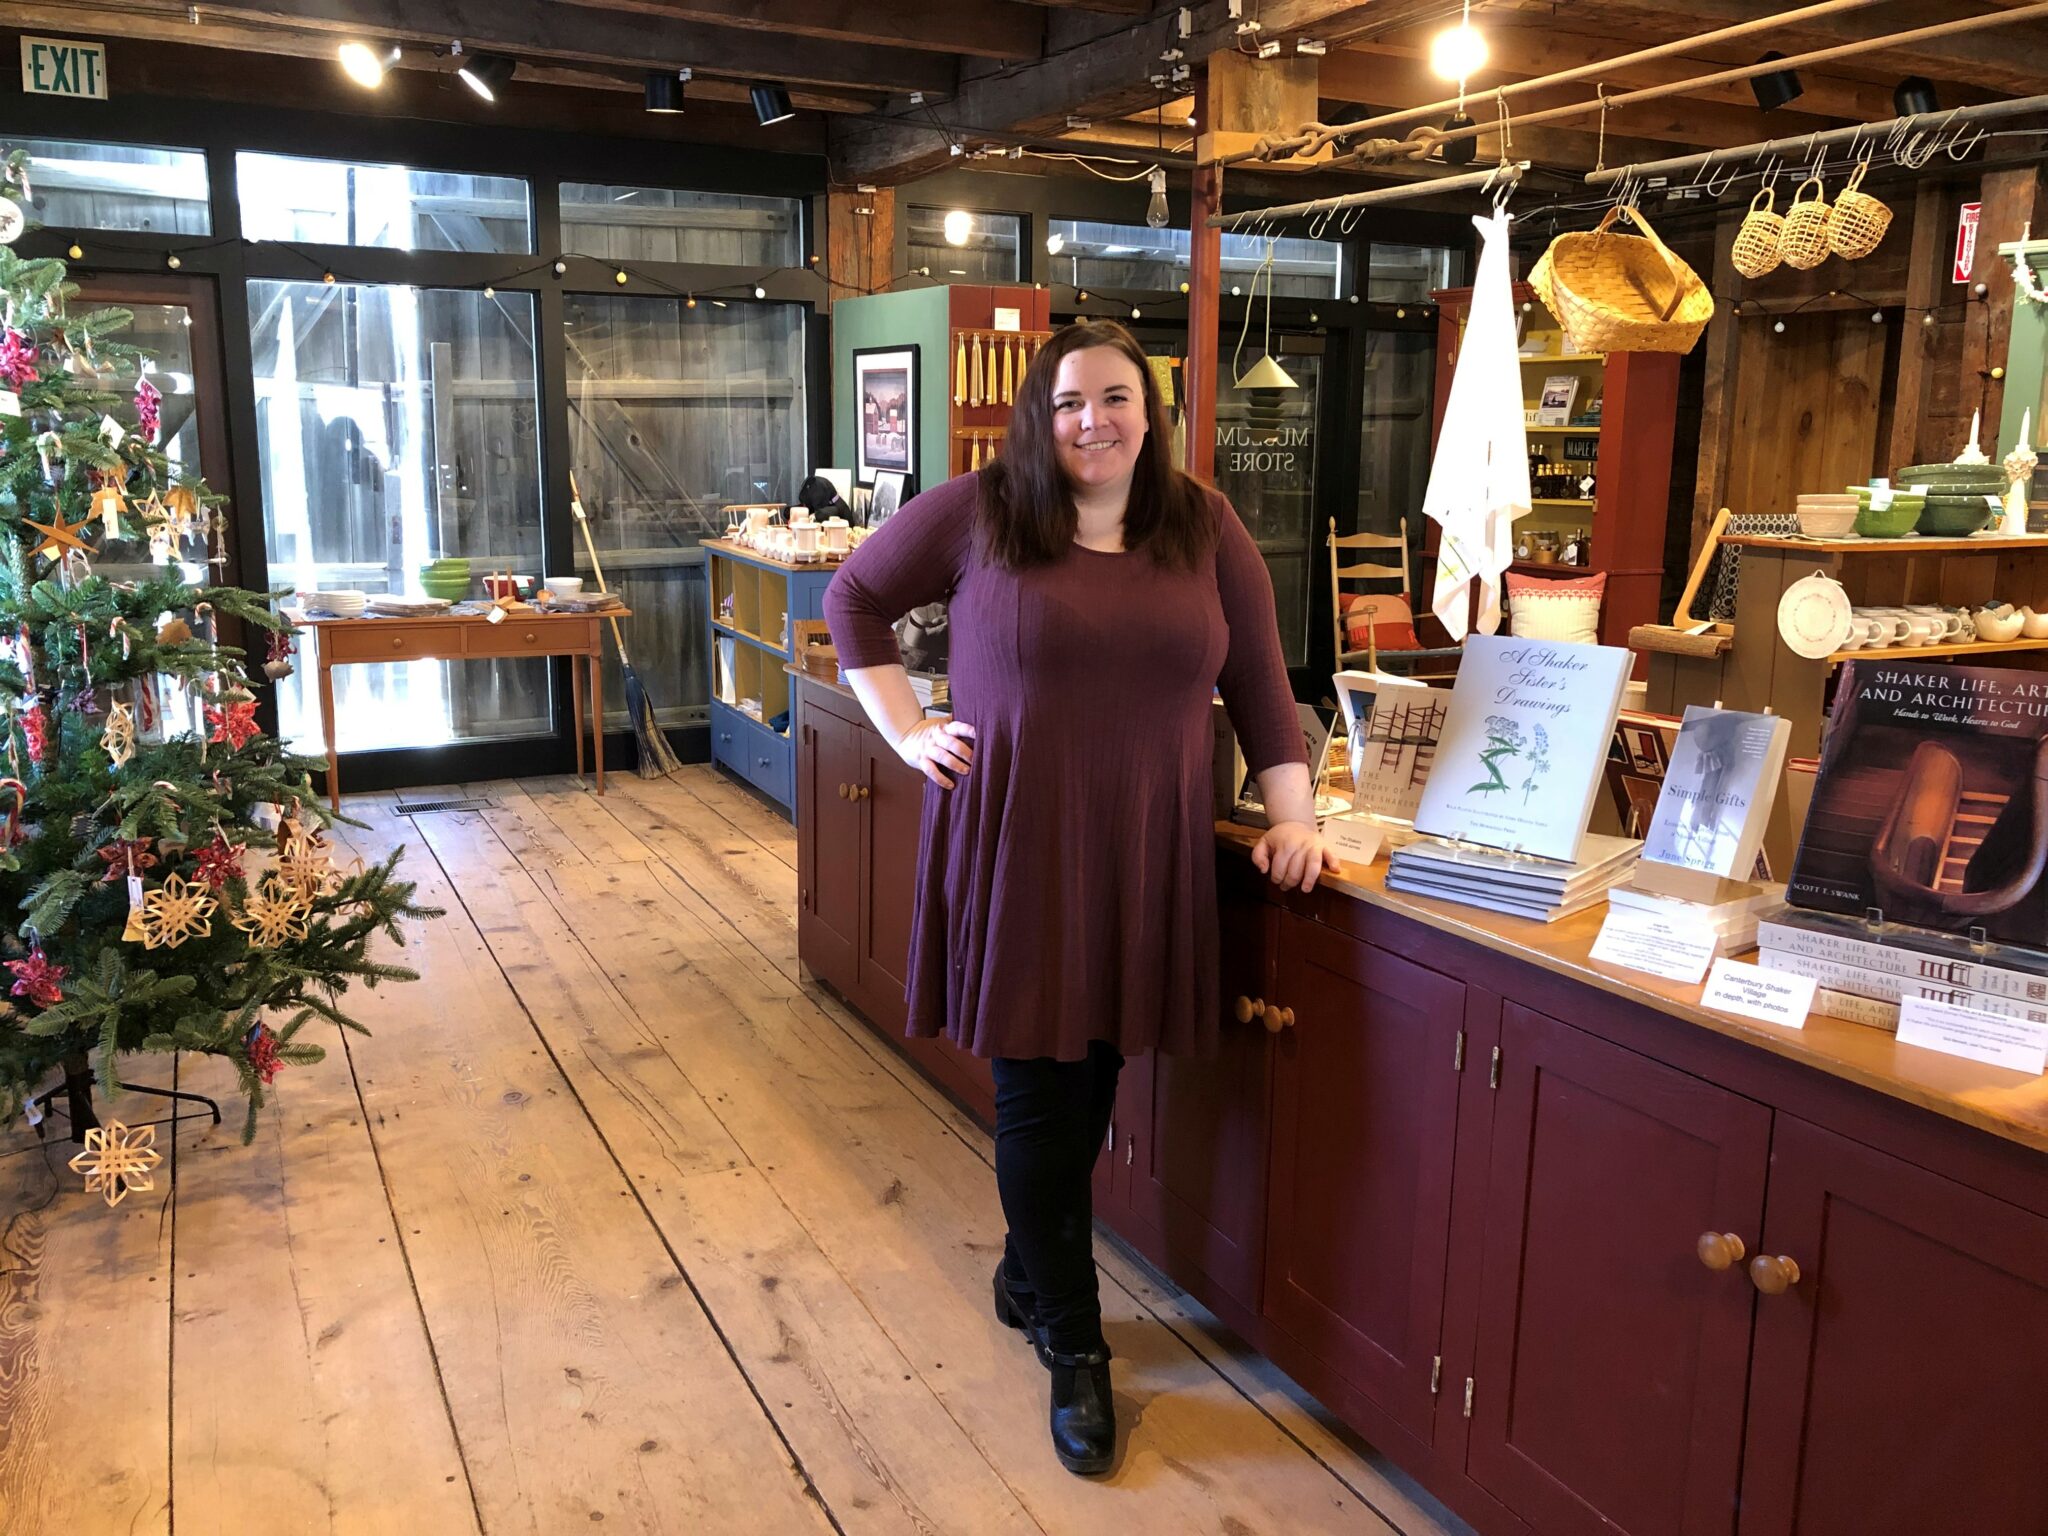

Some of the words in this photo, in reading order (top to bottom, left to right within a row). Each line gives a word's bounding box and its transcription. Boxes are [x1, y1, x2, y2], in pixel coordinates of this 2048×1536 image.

[32, 44, 99, 95] EXIT
[1966, 212, 1980, 223] FIRE
[1566, 440, 1590, 457] MAPLE
[1592, 442, 1599, 457] P
[1499, 648, 1532, 664] A
[1528, 648, 1589, 671] Shaker
[1508, 667, 1567, 691] Sister's
[1875, 671, 1949, 690] SHAKER
[1961, 678, 2001, 695] LIFE,
[2013, 684, 2048, 698] ART
[1494, 686, 1572, 719] Drawings
[1860, 687, 1902, 702] AND
[1911, 693, 2048, 717] ARCHITECTU
[1893, 708, 1919, 718] Hands
[1932, 712, 1959, 723] Work,
[1961, 715, 1988, 726] Hearts
[1989, 719, 1999, 727] to
[2000, 719, 2021, 729] God
[1667, 783, 1712, 804] Simple
[1715, 791, 1746, 808] Gifts
[1793, 883, 1820, 893] SCOTT
[1831, 889, 1860, 900] SWANK
[1796, 933, 1840, 949] SHAKER
[1790, 942, 1814, 954] AND
[1819, 950, 1906, 973] ARCHITECTURE
[1797, 959, 1840, 975] SHAKER
[1723, 974, 1763, 989] Canterbury
[1765, 983, 1792, 995] Shaker
[1743, 986, 1767, 998] Village
[1819, 976, 1902, 1000] ARCHITECTUR
[1723, 992, 1745, 1003] depth,
[1763, 1003, 1789, 1013] photos
[1827, 1009, 1896, 1029] CHITECTUR
